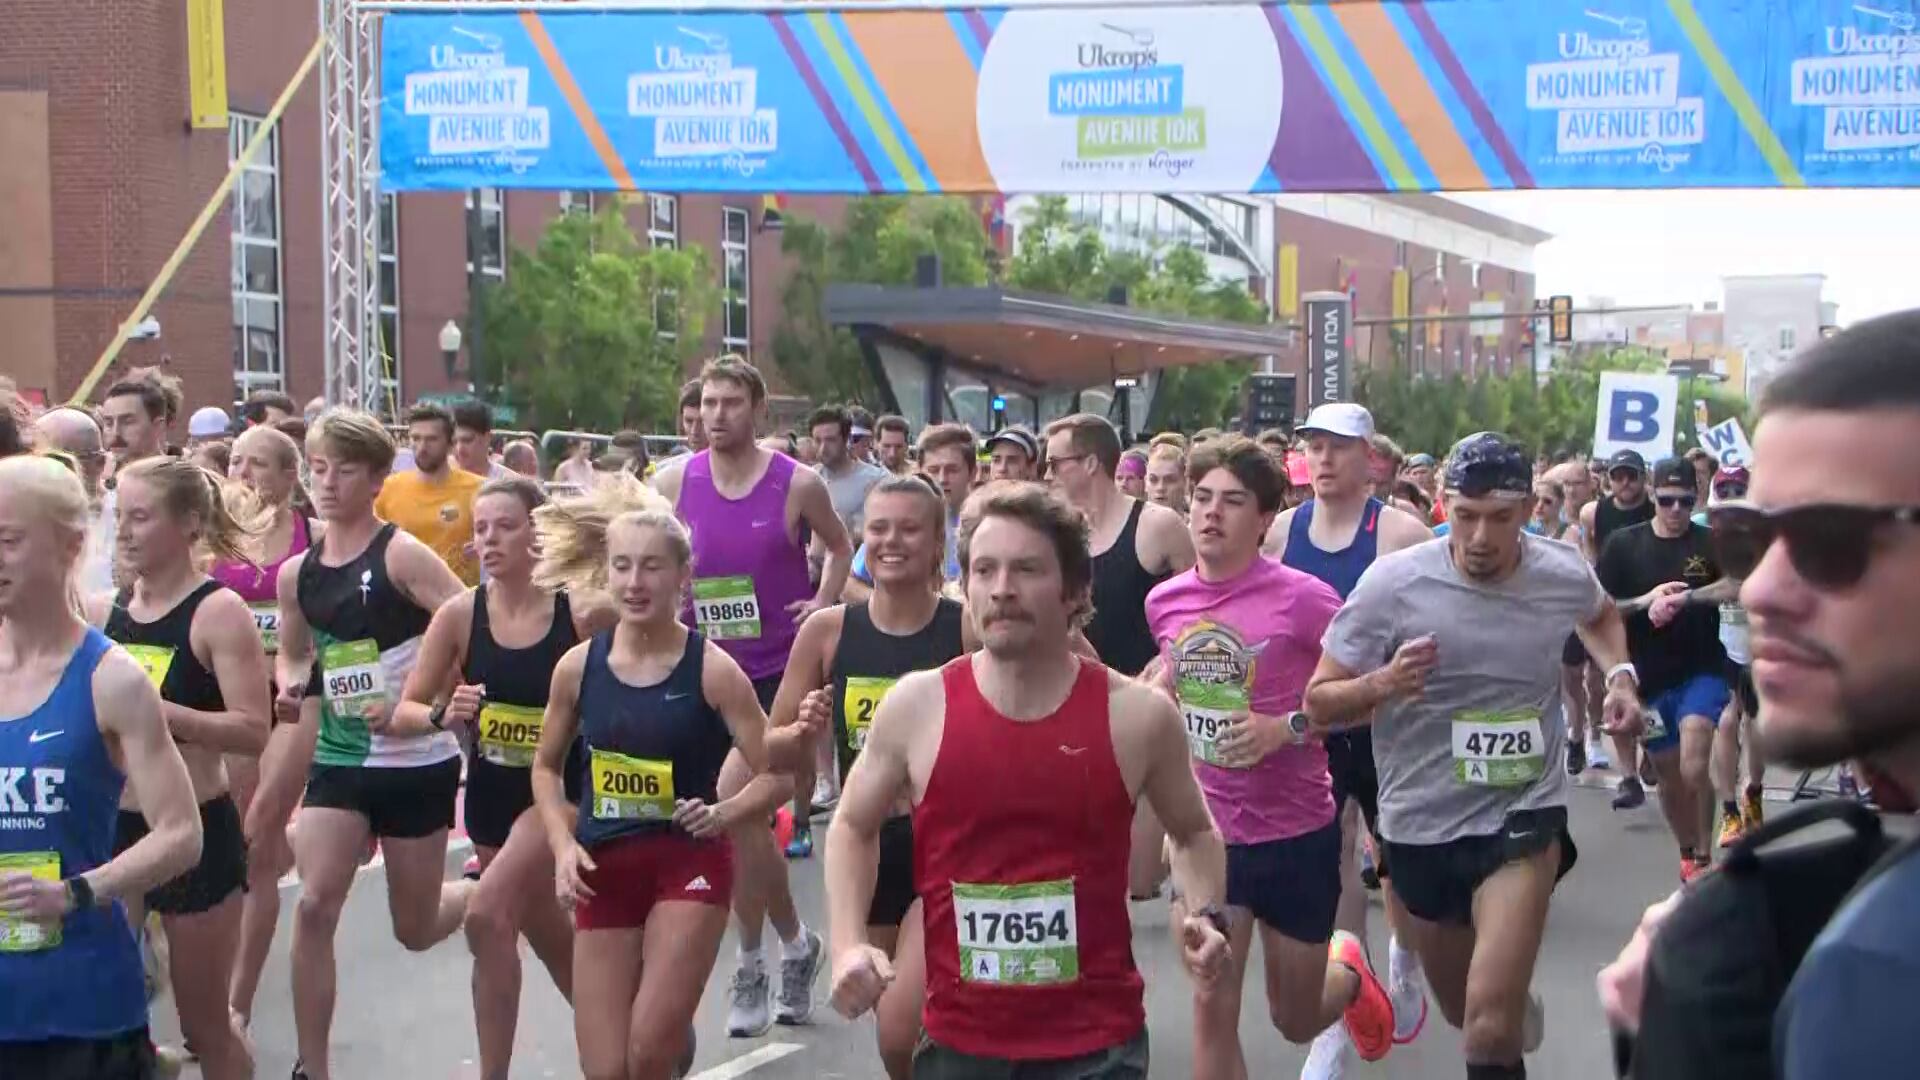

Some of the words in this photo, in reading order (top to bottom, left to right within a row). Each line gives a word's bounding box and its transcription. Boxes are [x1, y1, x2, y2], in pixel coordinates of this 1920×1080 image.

[412, 79, 517, 107] MONUMENT
[636, 81, 742, 108] MONUMENT
[1056, 77, 1173, 110] MONUMENT
[1536, 66, 1665, 100] MONUMENT
[436, 118, 505, 142] AVENUE
[662, 120, 732, 144] AVENUE
[1085, 118, 1158, 145] AVENUE
[1166, 117, 1199, 144] 10K
[1566, 111, 1650, 140] AVENUE
[1659, 109, 1696, 137] 10K
[1148, 150, 1194, 177] Kroger
[1324, 309, 1338, 344] VCU
[1324, 349, 1338, 361] &
[1324, 365, 1338, 400] VUU
[1608, 390, 1660, 443] B
[1705, 422, 1735, 450] W
[254, 614, 281, 631] 72
[699, 601, 755, 621] 19869
[1178, 661, 1240, 673] INVITATIONAL
[329, 672, 373, 696] 9500
[487, 719, 542, 743] 2005
[1466, 731, 1532, 756] 4728
[1471, 763, 1483, 778] A
[603, 771, 660, 796] 2006
[0, 817, 46, 831] NNING
[964, 909, 1069, 944] 17654
[979, 959, 989, 975] A
